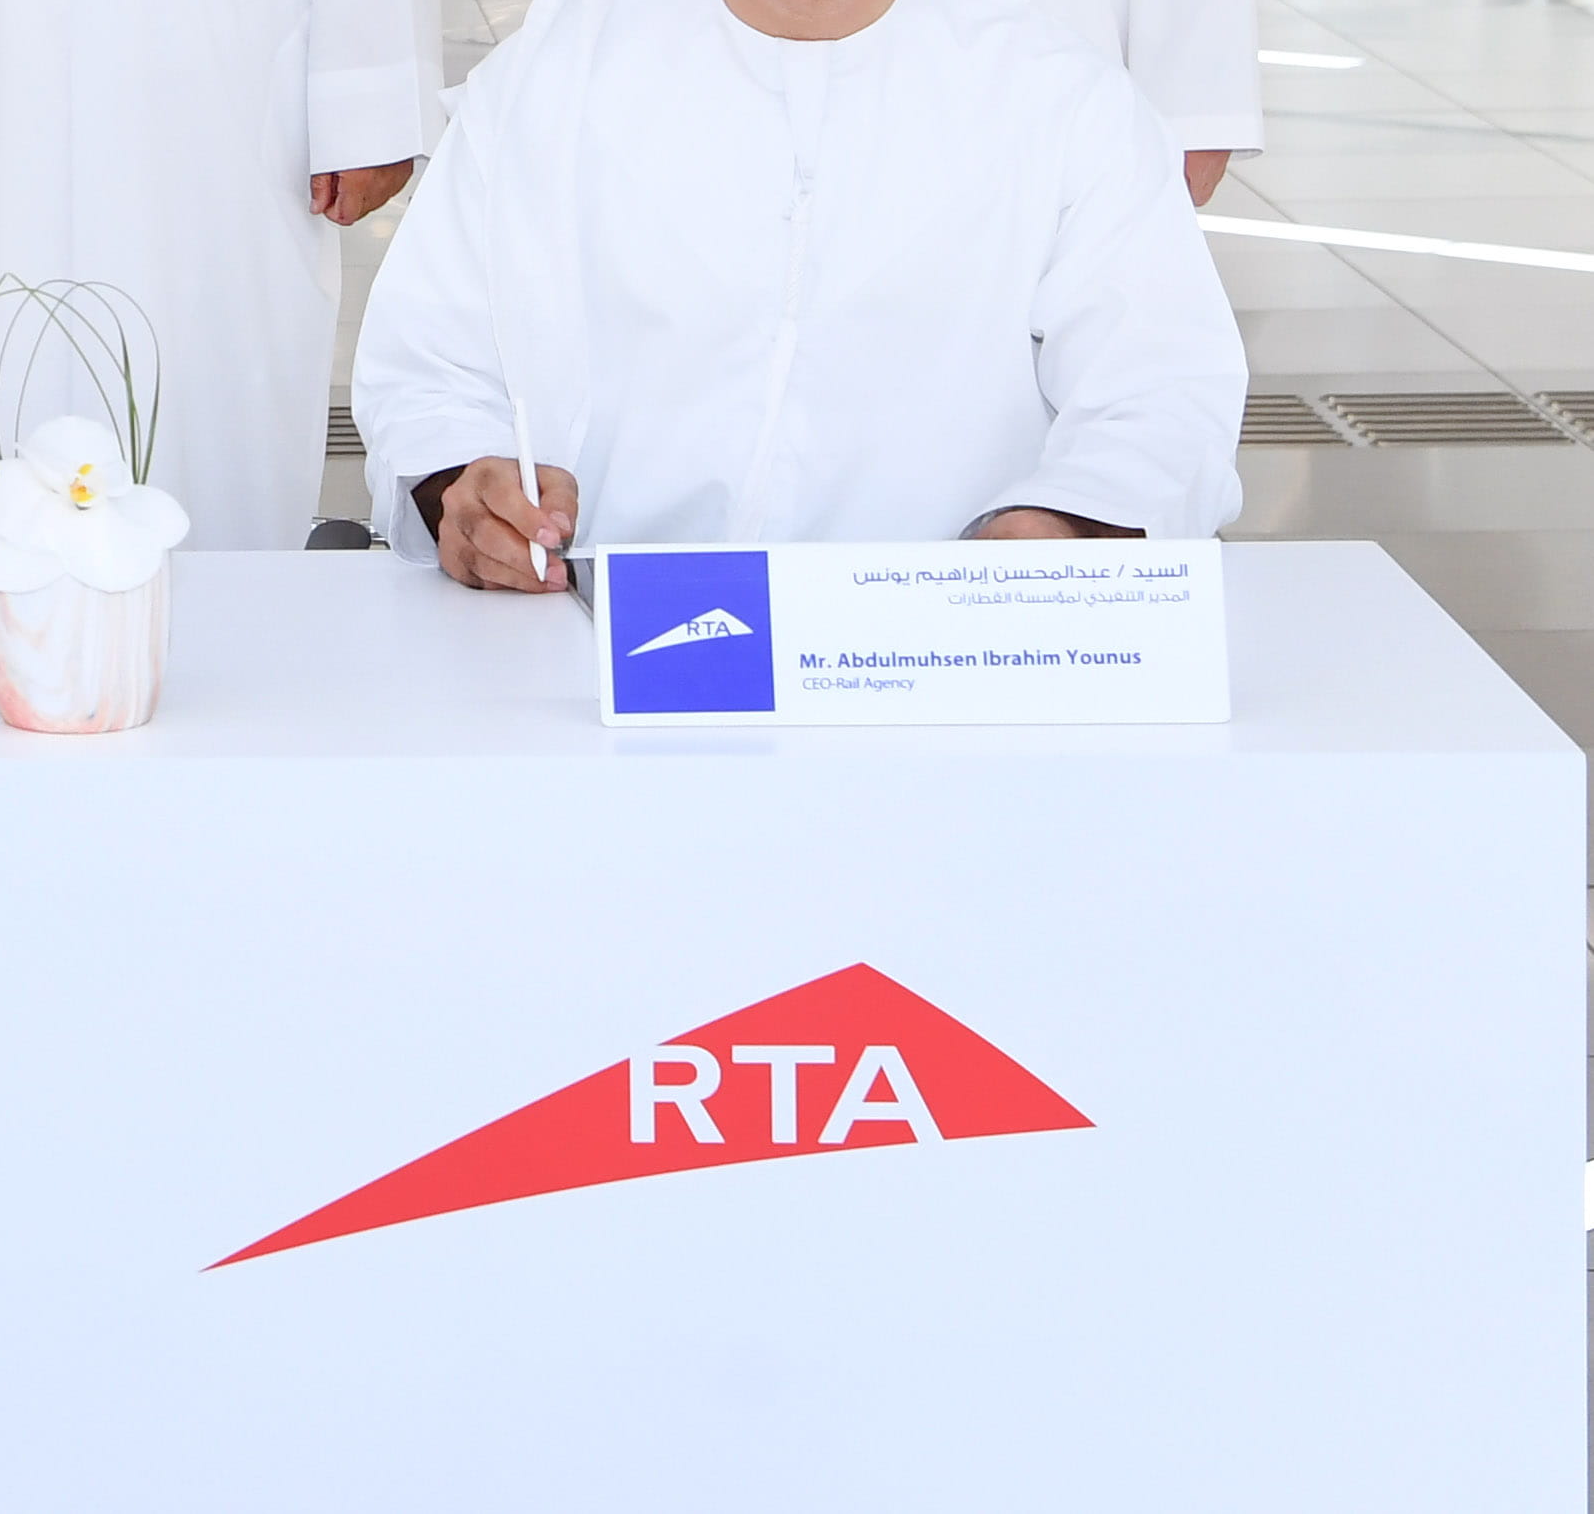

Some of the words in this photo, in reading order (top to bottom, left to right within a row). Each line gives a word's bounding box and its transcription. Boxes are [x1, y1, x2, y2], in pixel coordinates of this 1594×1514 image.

[853, 569, 909, 586] يونس
[993, 564, 1111, 583] عبدالمحسن
[1133, 563, 1189, 583] السيد
[686, 621, 731, 636] RTA
[800, 653, 832, 669] Mr.
[837, 652, 977, 669] Abdulmuhsen
[983, 650, 1061, 667] Ibrahim
[1066, 649, 1142, 665] Younus
[802, 677, 859, 691] CEO-Rail
[863, 676, 915, 692] Agency
[629, 1044, 946, 1144] RTA
